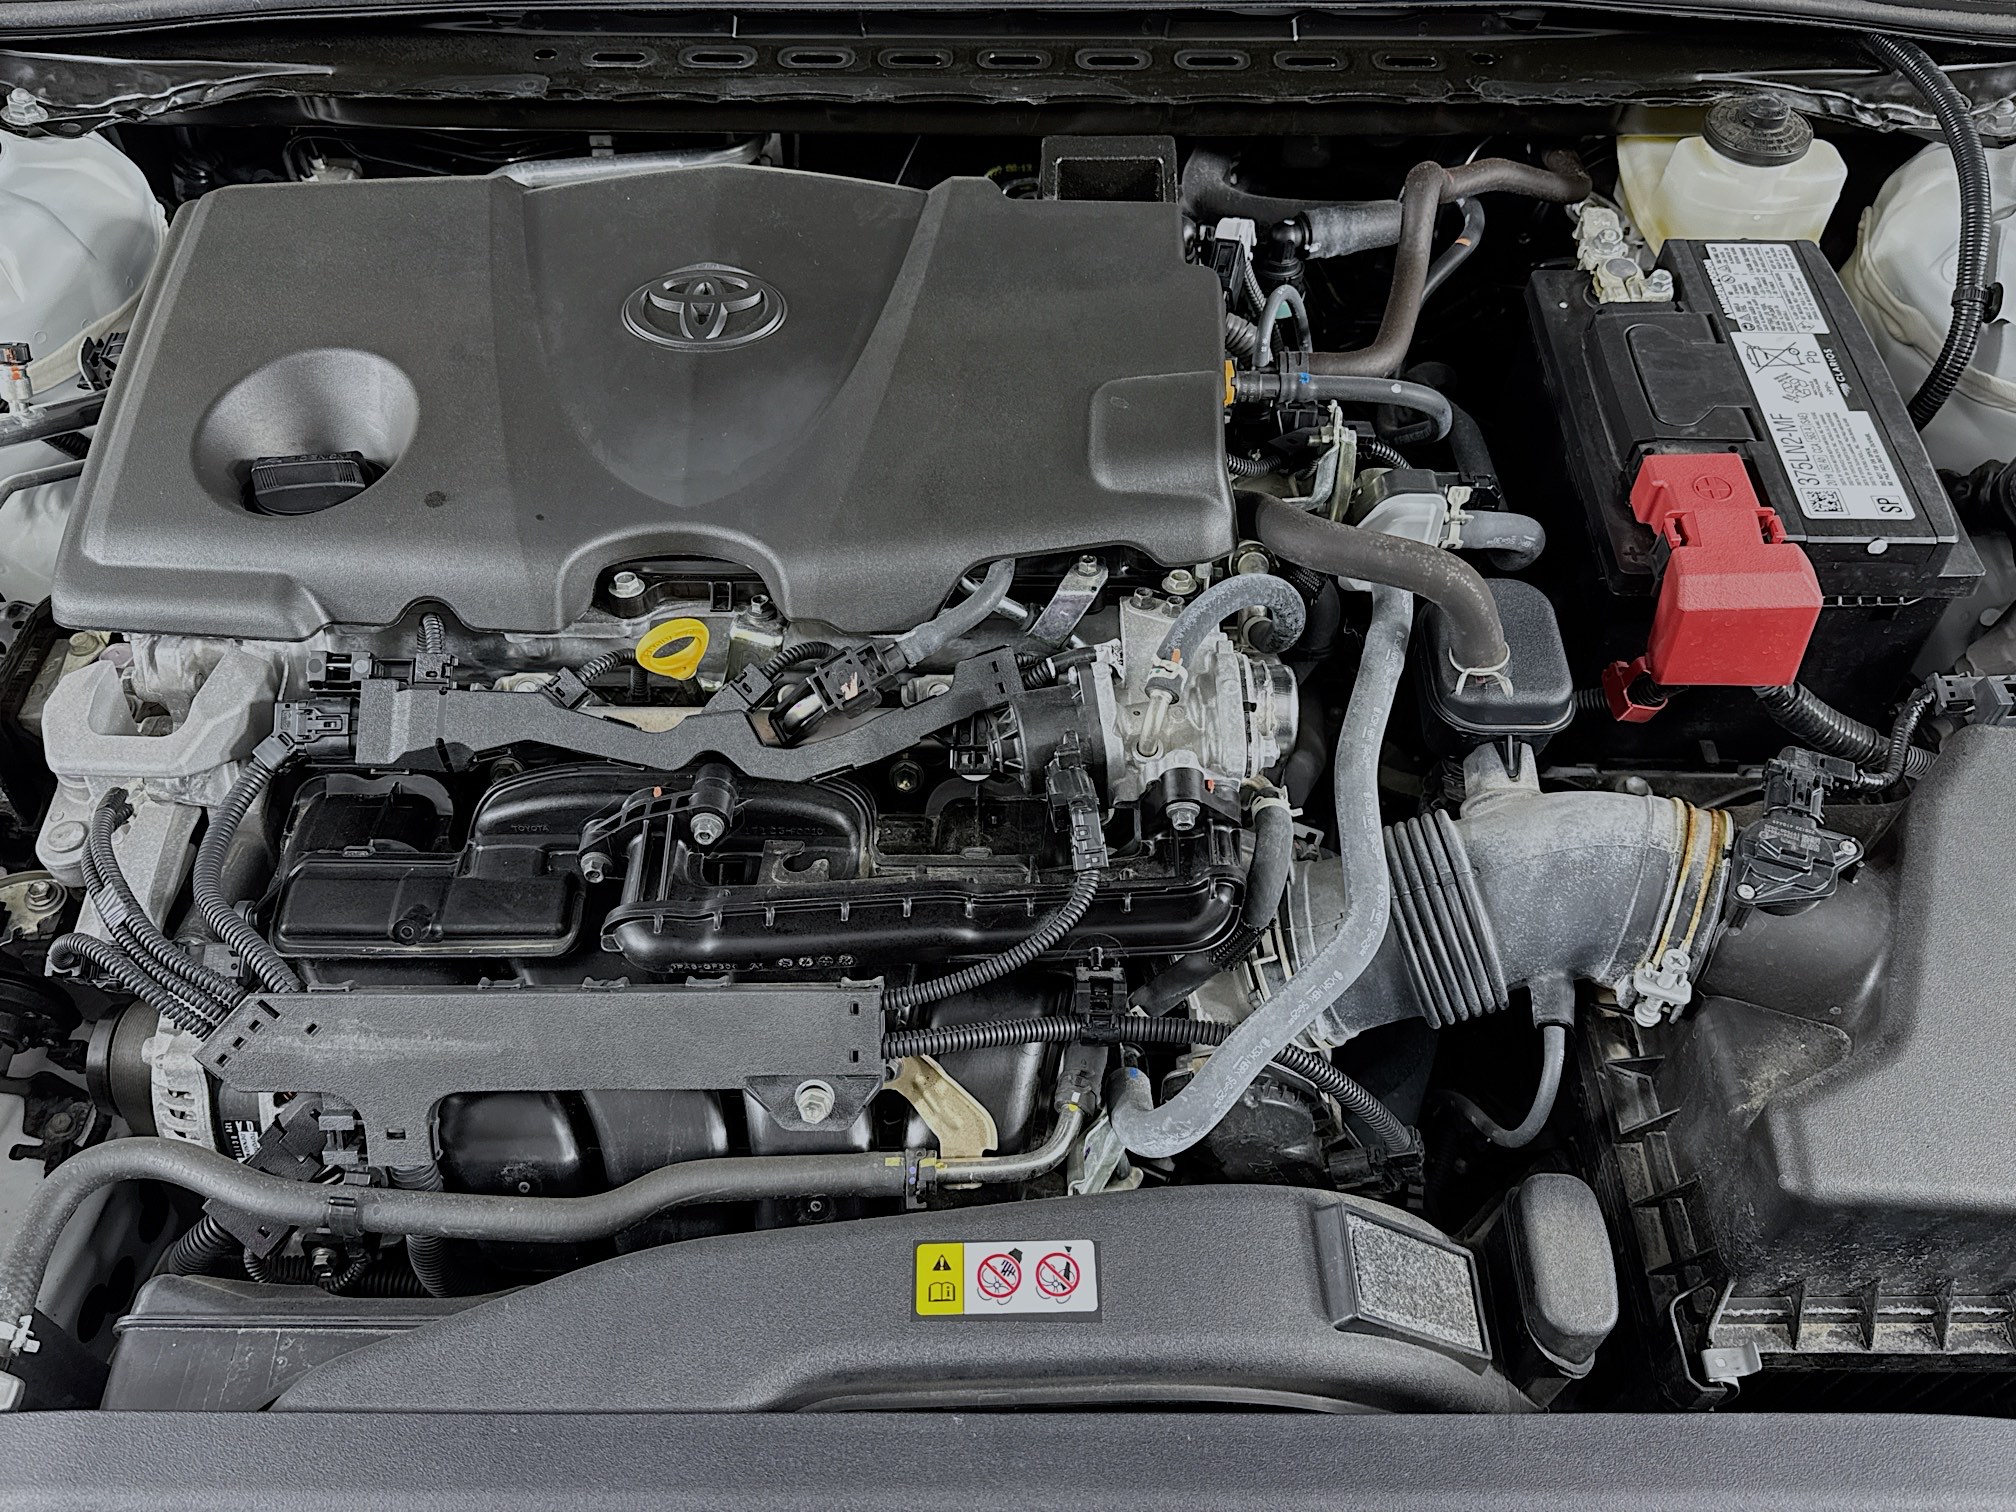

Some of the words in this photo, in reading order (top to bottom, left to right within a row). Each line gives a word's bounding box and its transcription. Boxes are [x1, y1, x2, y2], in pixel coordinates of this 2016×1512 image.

[1803, 350, 1820, 363] Pb
[1823, 348, 1846, 381] CLARIOS
[1769, 412, 1820, 485] 375LN2-MF
[1876, 497, 1902, 512] SP
